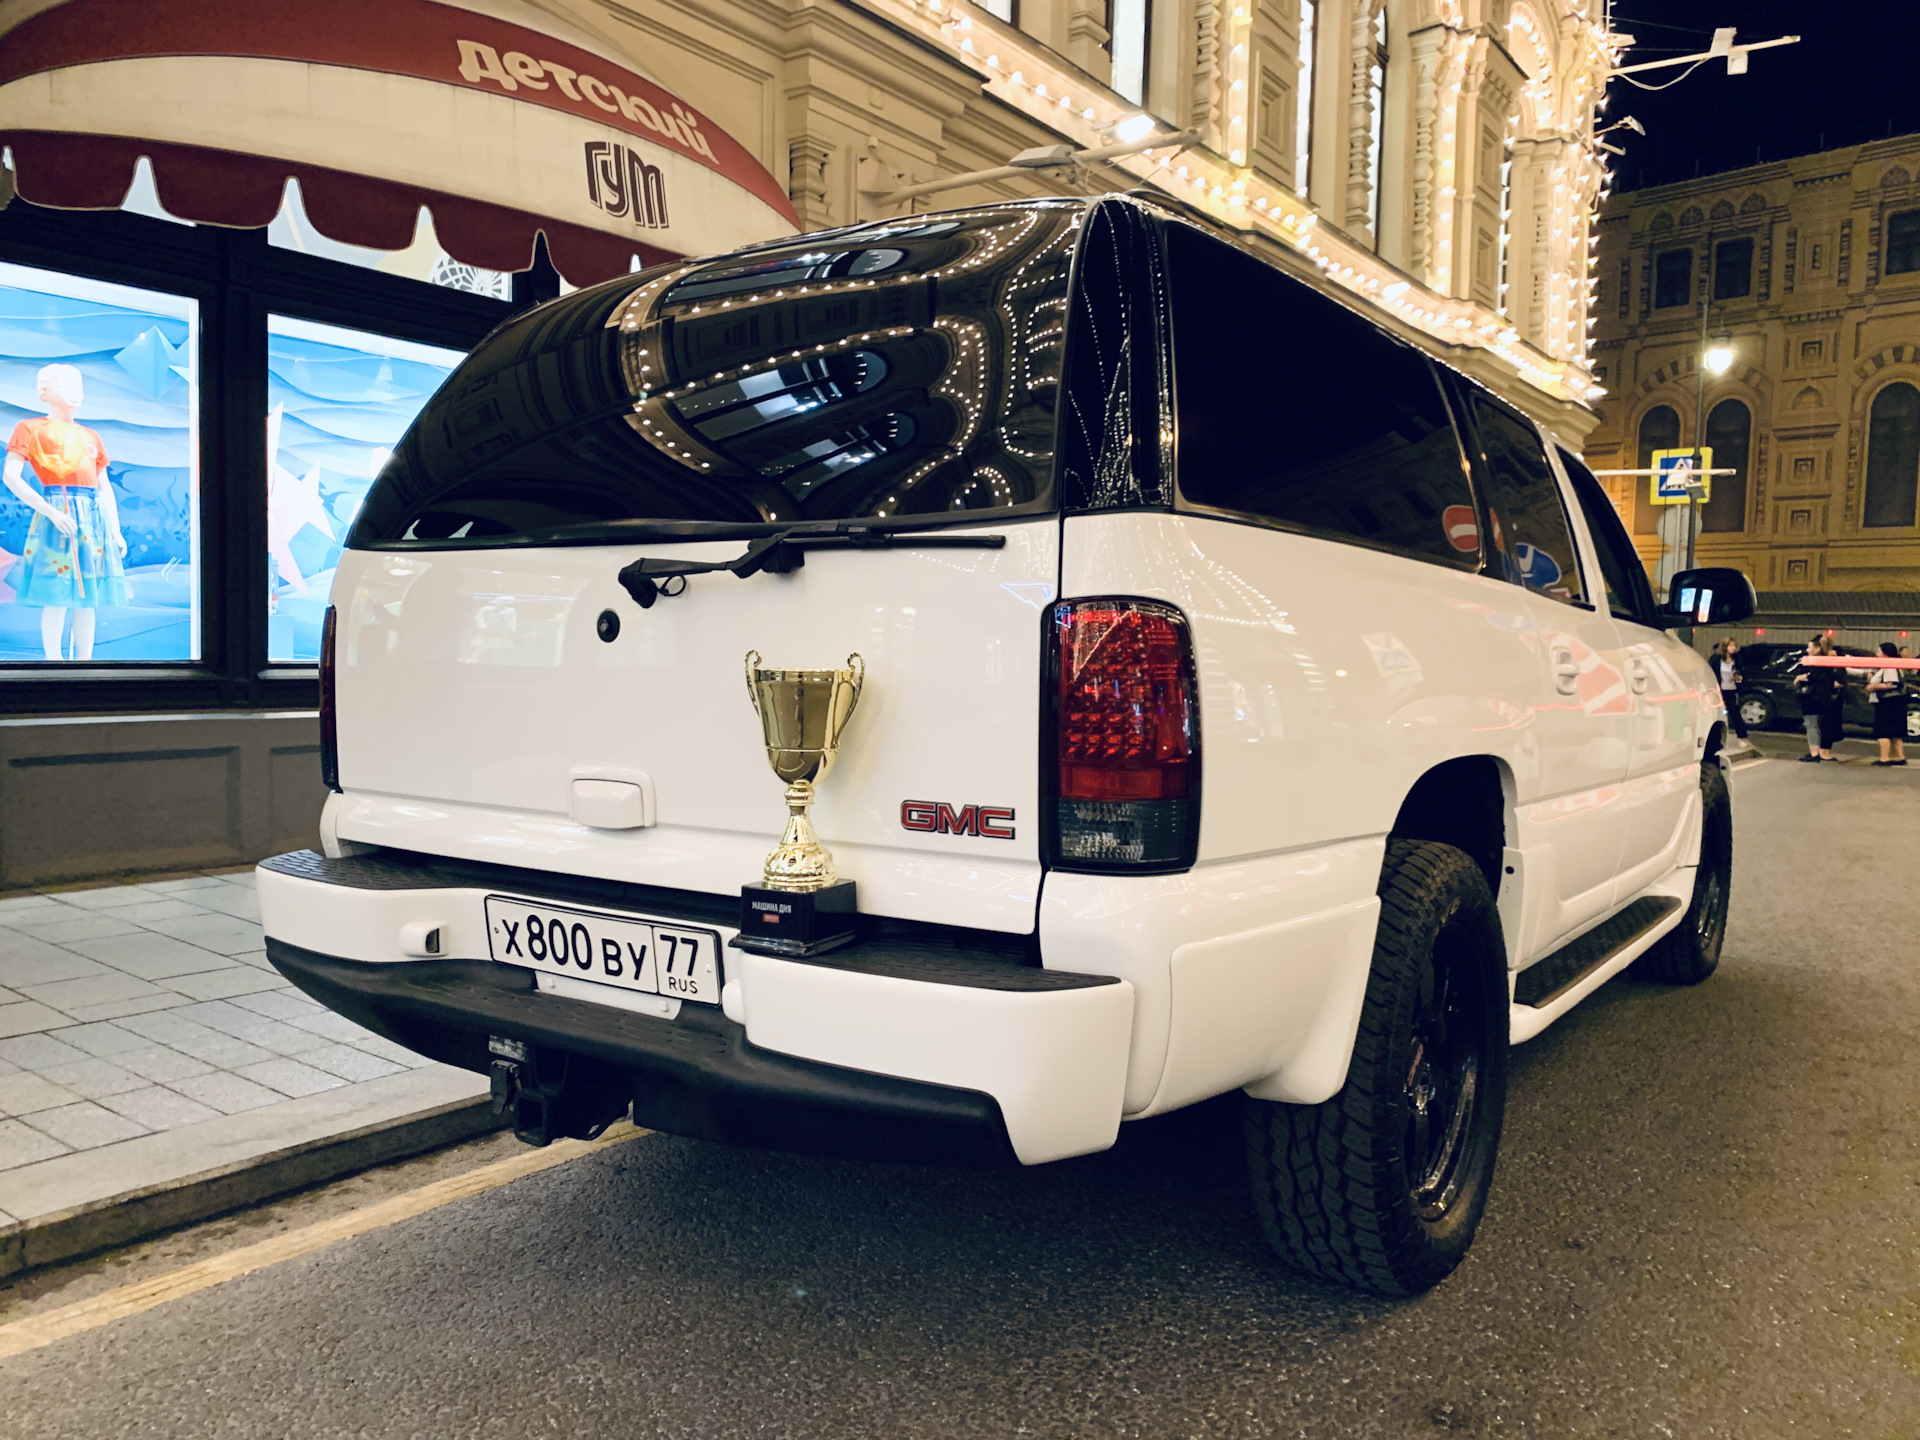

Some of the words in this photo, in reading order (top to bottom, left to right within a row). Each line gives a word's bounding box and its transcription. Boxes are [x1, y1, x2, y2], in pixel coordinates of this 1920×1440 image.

[456, 39, 720, 165] Детский
[900, 799, 1015, 840] GMC
[752, 901, 778, 912] МАШИНА
[778, 903, 792, 914] ДНЯ
[659, 934, 699, 976] 77
[668, 976, 698, 994] RUS
